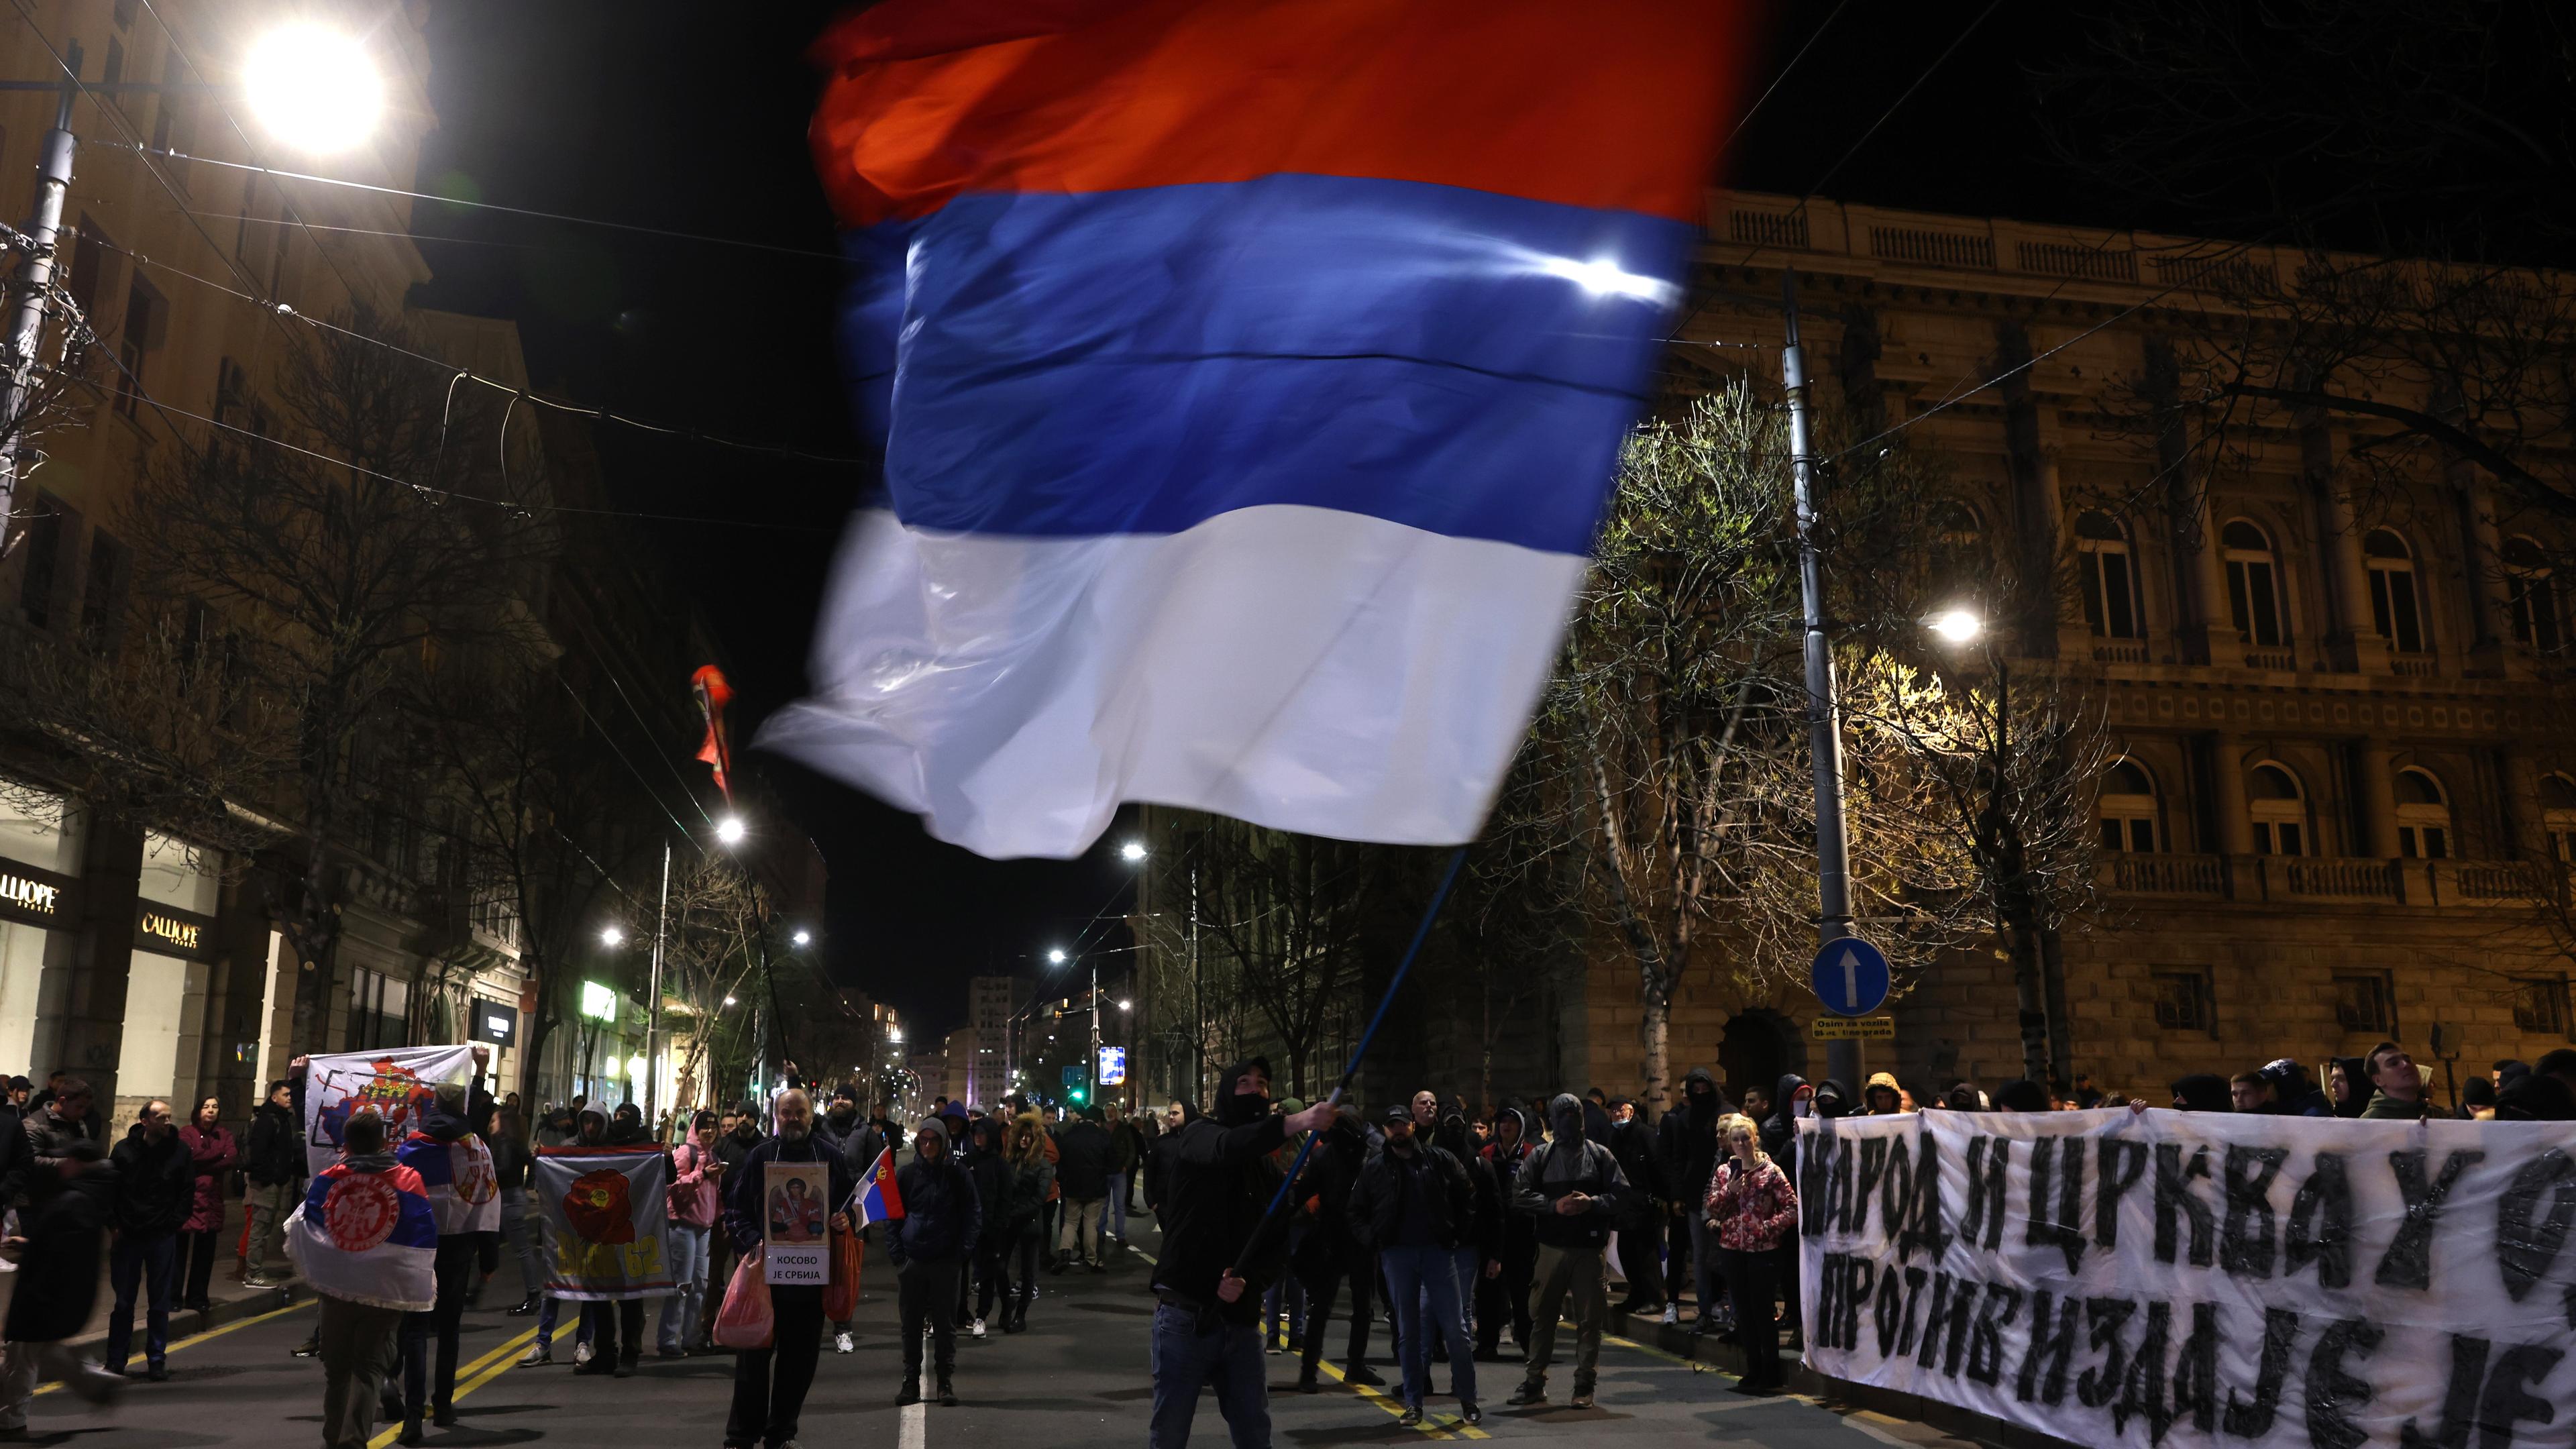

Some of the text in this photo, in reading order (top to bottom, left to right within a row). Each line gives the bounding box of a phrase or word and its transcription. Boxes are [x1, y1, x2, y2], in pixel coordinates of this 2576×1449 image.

[0, 874, 60, 908] LLIOPE
[142, 912, 201, 944] CALLIOPE
[1862, 1028, 1892, 1037] grada
[1801, 1130, 1953, 1266] НАРОД
[1961, 1135, 2010, 1254] И
[2026, 1134, 2352, 1289] ЦРКВА
[624, 1234, 663, 1278] 62
[777, 1256, 818, 1265] КОСОВО
[773, 1271, 820, 1279] ЈЕ СРБИЈА
[1818, 1253, 2022, 1387] ПРОТИВ
[2017, 1289, 2385, 1449] ИЗДАЈЕ
